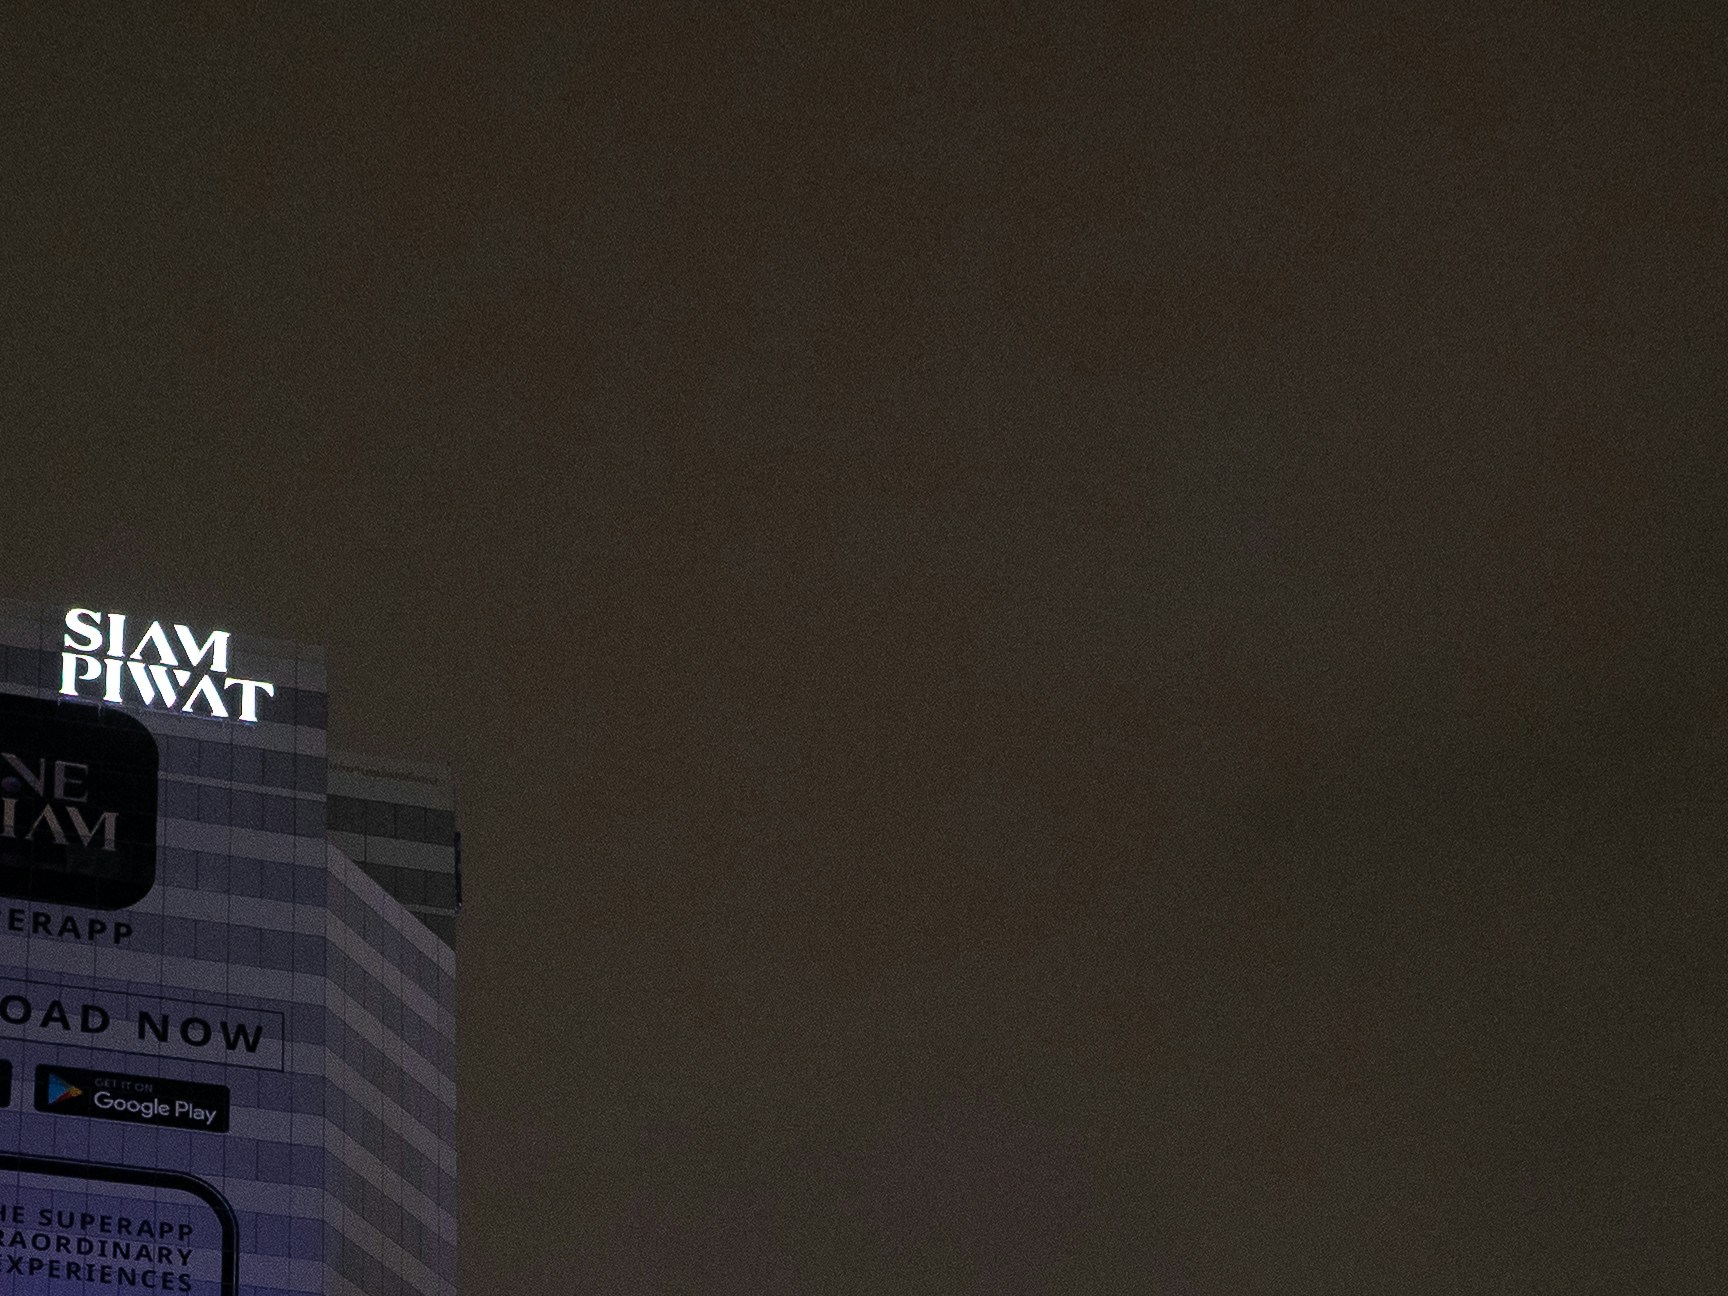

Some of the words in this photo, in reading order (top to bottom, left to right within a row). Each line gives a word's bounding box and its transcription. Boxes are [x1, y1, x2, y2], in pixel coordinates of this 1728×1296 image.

[63, 608, 232, 673] SIAM
[59, 651, 275, 723] PIWAT
[137, 1010, 265, 1054] NOW
[94, 1078, 117, 1088] GET
[121, 1081, 132, 1091] IT
[134, 1083, 154, 1093] ON
[93, 1091, 171, 1119] Google
[175, 1100, 217, 1125] Play
[38, 1208, 194, 1241] SUPERAPP
